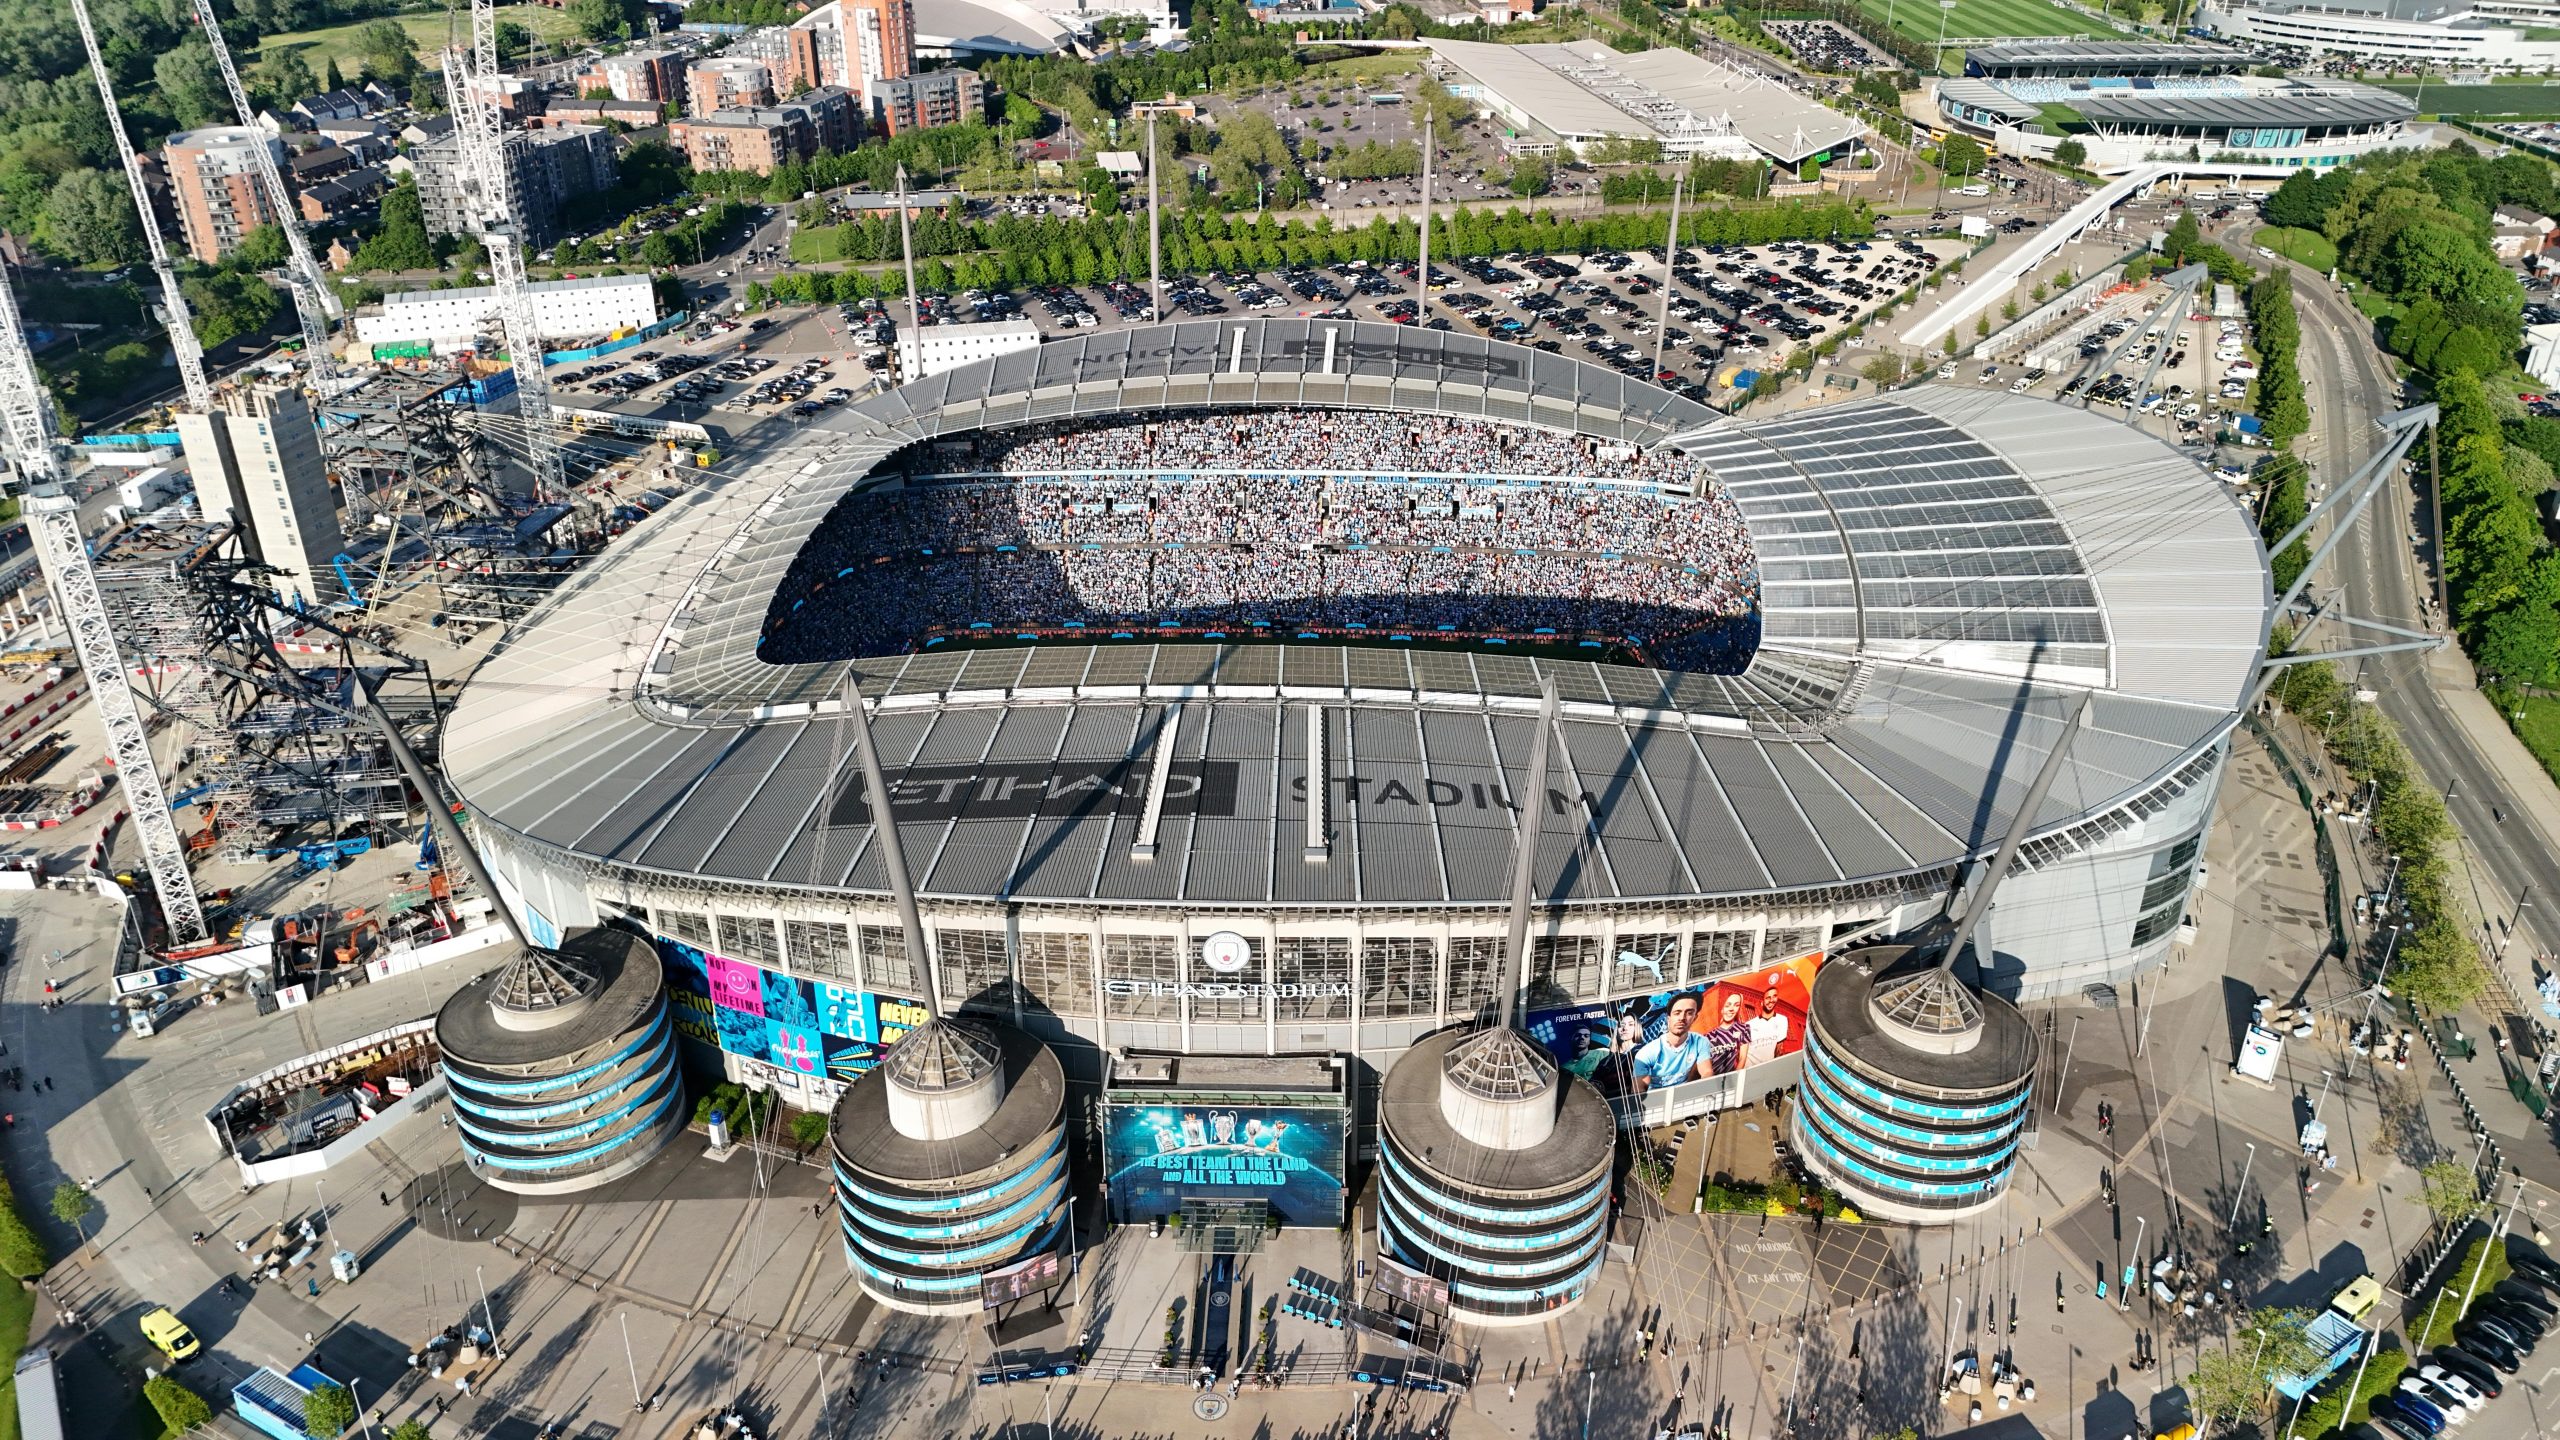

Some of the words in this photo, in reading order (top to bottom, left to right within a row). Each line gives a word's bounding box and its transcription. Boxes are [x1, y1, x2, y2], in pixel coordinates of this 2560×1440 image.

[709, 958, 726, 971] NOT
[713, 980, 728, 993] MY
[1105, 980, 1232, 998] ETIHAD
[1238, 982, 1350, 998] STADIUM
[714, 992, 761, 1014] LIFETIME
[1555, 1013, 1582, 1023] FOREVER.
[1583, 1010, 1607, 1019] FASTER.
[1140, 1158, 1156, 1167] THE
[1157, 1156, 1190, 1170] BEST
[1191, 1156, 1228, 1170] TEAM
[1231, 1156, 1246, 1170] IN
[1247, 1157, 1271, 1170] THE
[1274, 1157, 1309, 1171] LAND
[1162, 1171, 1182, 1182] AND
[1183, 1169, 1208, 1184] ALL
[1209, 1170, 1233, 1184] THE
[1234, 1170, 1286, 1185] WORLD
[1735, 1244, 1751, 1253] NO
[1757, 1242, 1792, 1252] PARKING
[1747, 1274, 1759, 1284] AT
[1763, 1273, 1780, 1283] ANY
[1782, 1272, 1805, 1282] TIME
